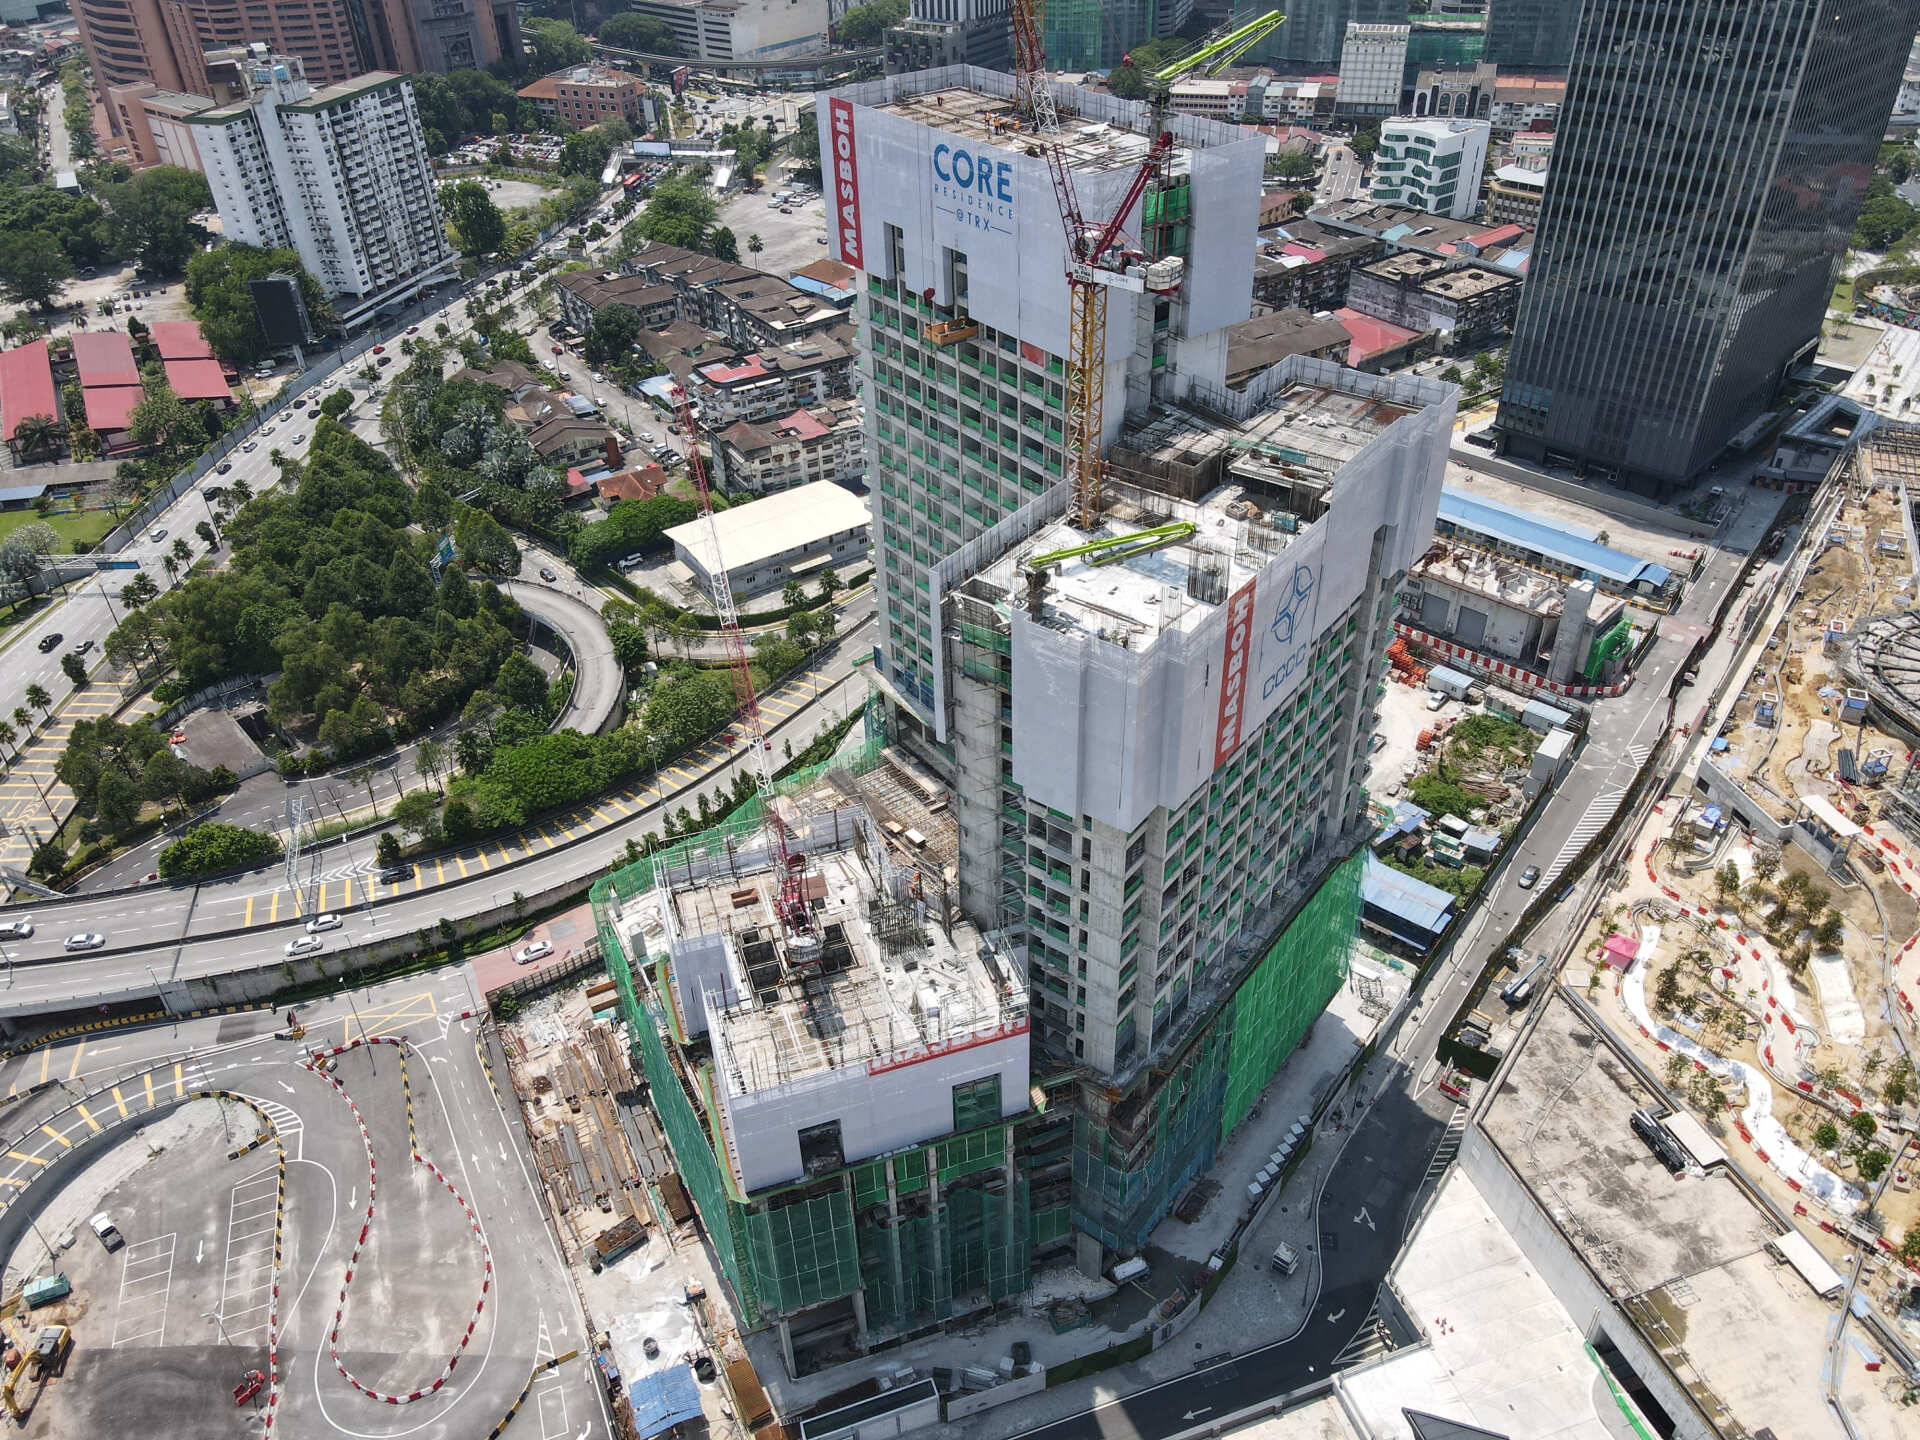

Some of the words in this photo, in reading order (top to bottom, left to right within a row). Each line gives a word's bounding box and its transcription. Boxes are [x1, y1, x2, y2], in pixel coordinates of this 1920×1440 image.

[835, 108, 858, 258] MASBOH
[933, 143, 1013, 203] CORE
[934, 183, 1014, 220] RESIDENCE
[956, 208, 990, 232] @TRX
[1221, 592, 1250, 752] MASBOH
[1263, 642, 1307, 700] CCCC
